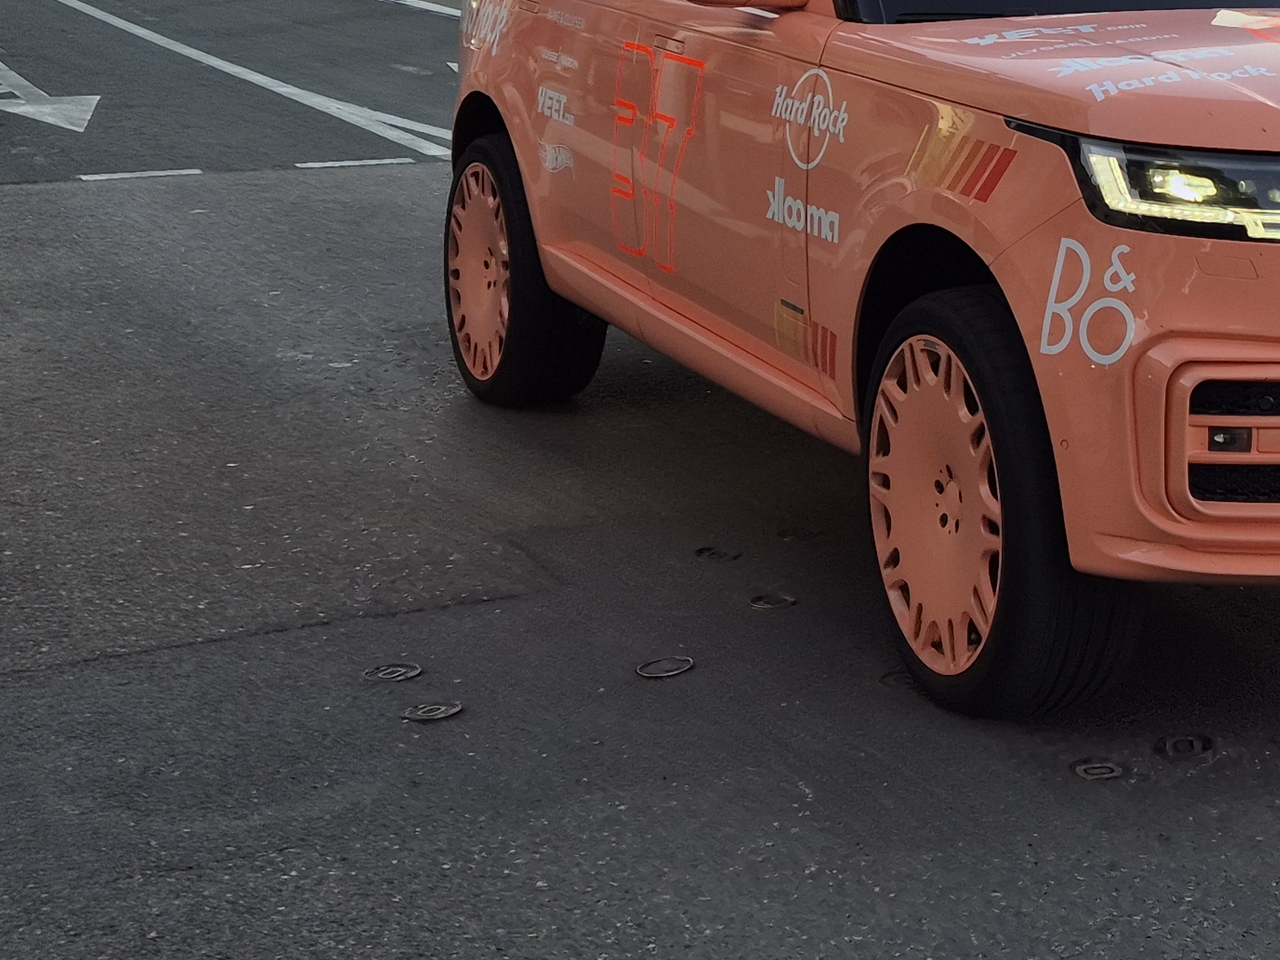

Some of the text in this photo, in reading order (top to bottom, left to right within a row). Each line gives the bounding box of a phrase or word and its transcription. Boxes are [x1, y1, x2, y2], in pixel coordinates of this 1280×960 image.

[1086, 70, 1181, 102] Hard
[771, 84, 848, 143] Hard Rock
